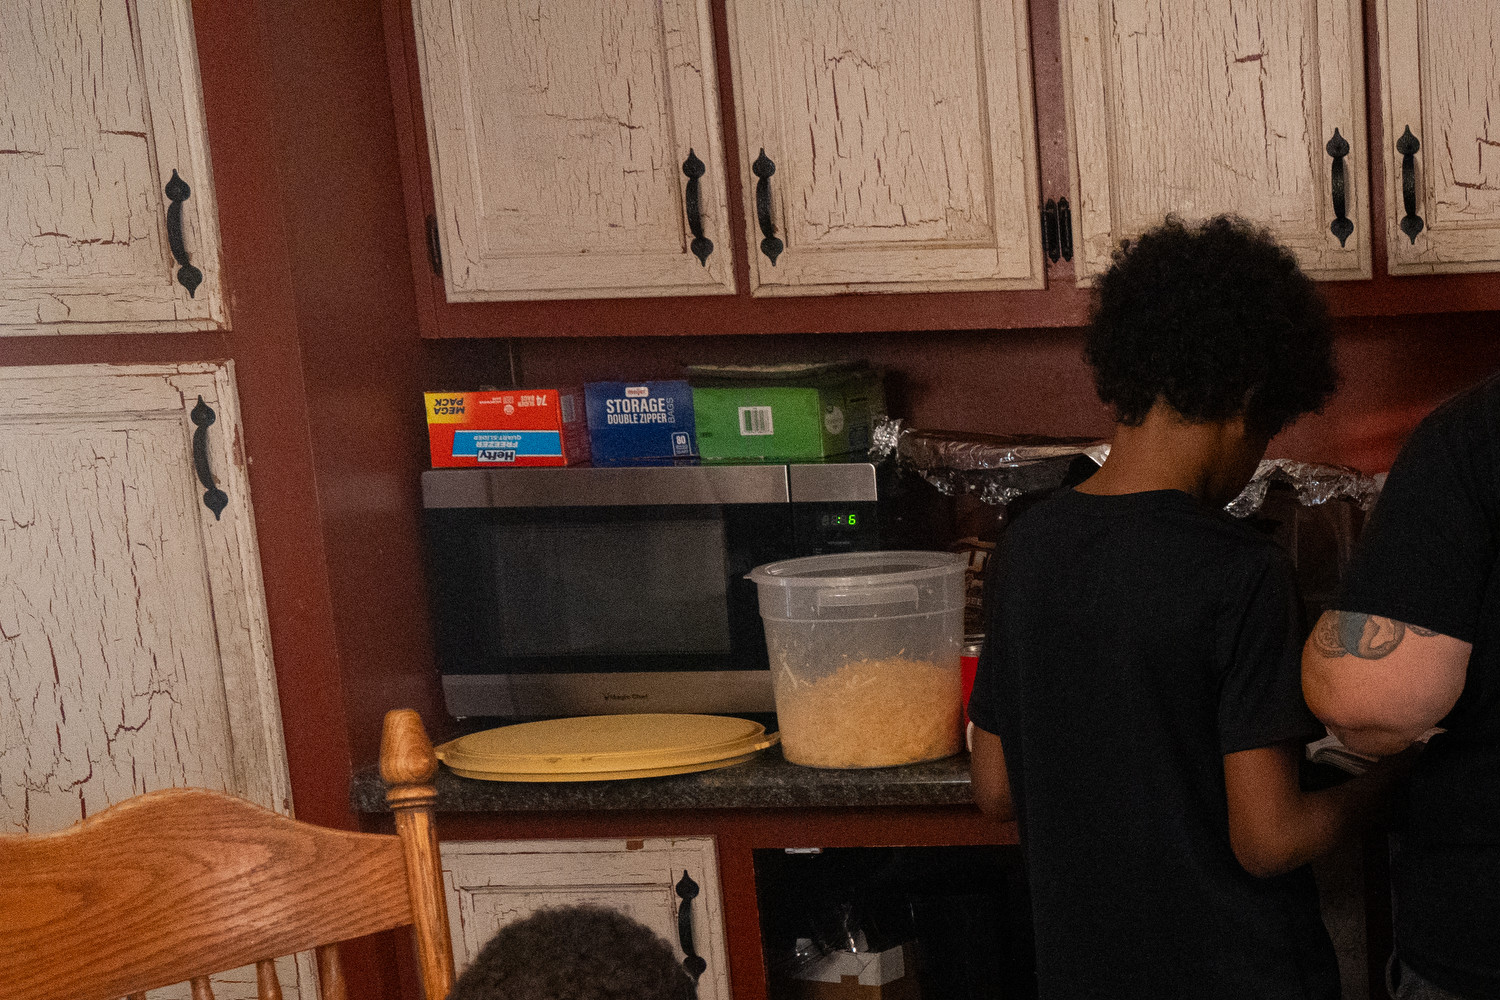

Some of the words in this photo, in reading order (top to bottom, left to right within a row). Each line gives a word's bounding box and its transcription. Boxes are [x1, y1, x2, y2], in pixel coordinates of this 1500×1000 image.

[435, 398, 463, 406] PACK
[536, 395, 547, 406] 74
[606, 398, 665, 413] STORAGE
[434, 406, 464, 414] MEGA
[667, 397, 675, 423] BAGS
[607, 414, 638, 424] DOUBLE
[639, 413, 667, 423] ZIPPER
[676, 435, 686, 444] 80
[480, 451, 514, 460] Hefty
